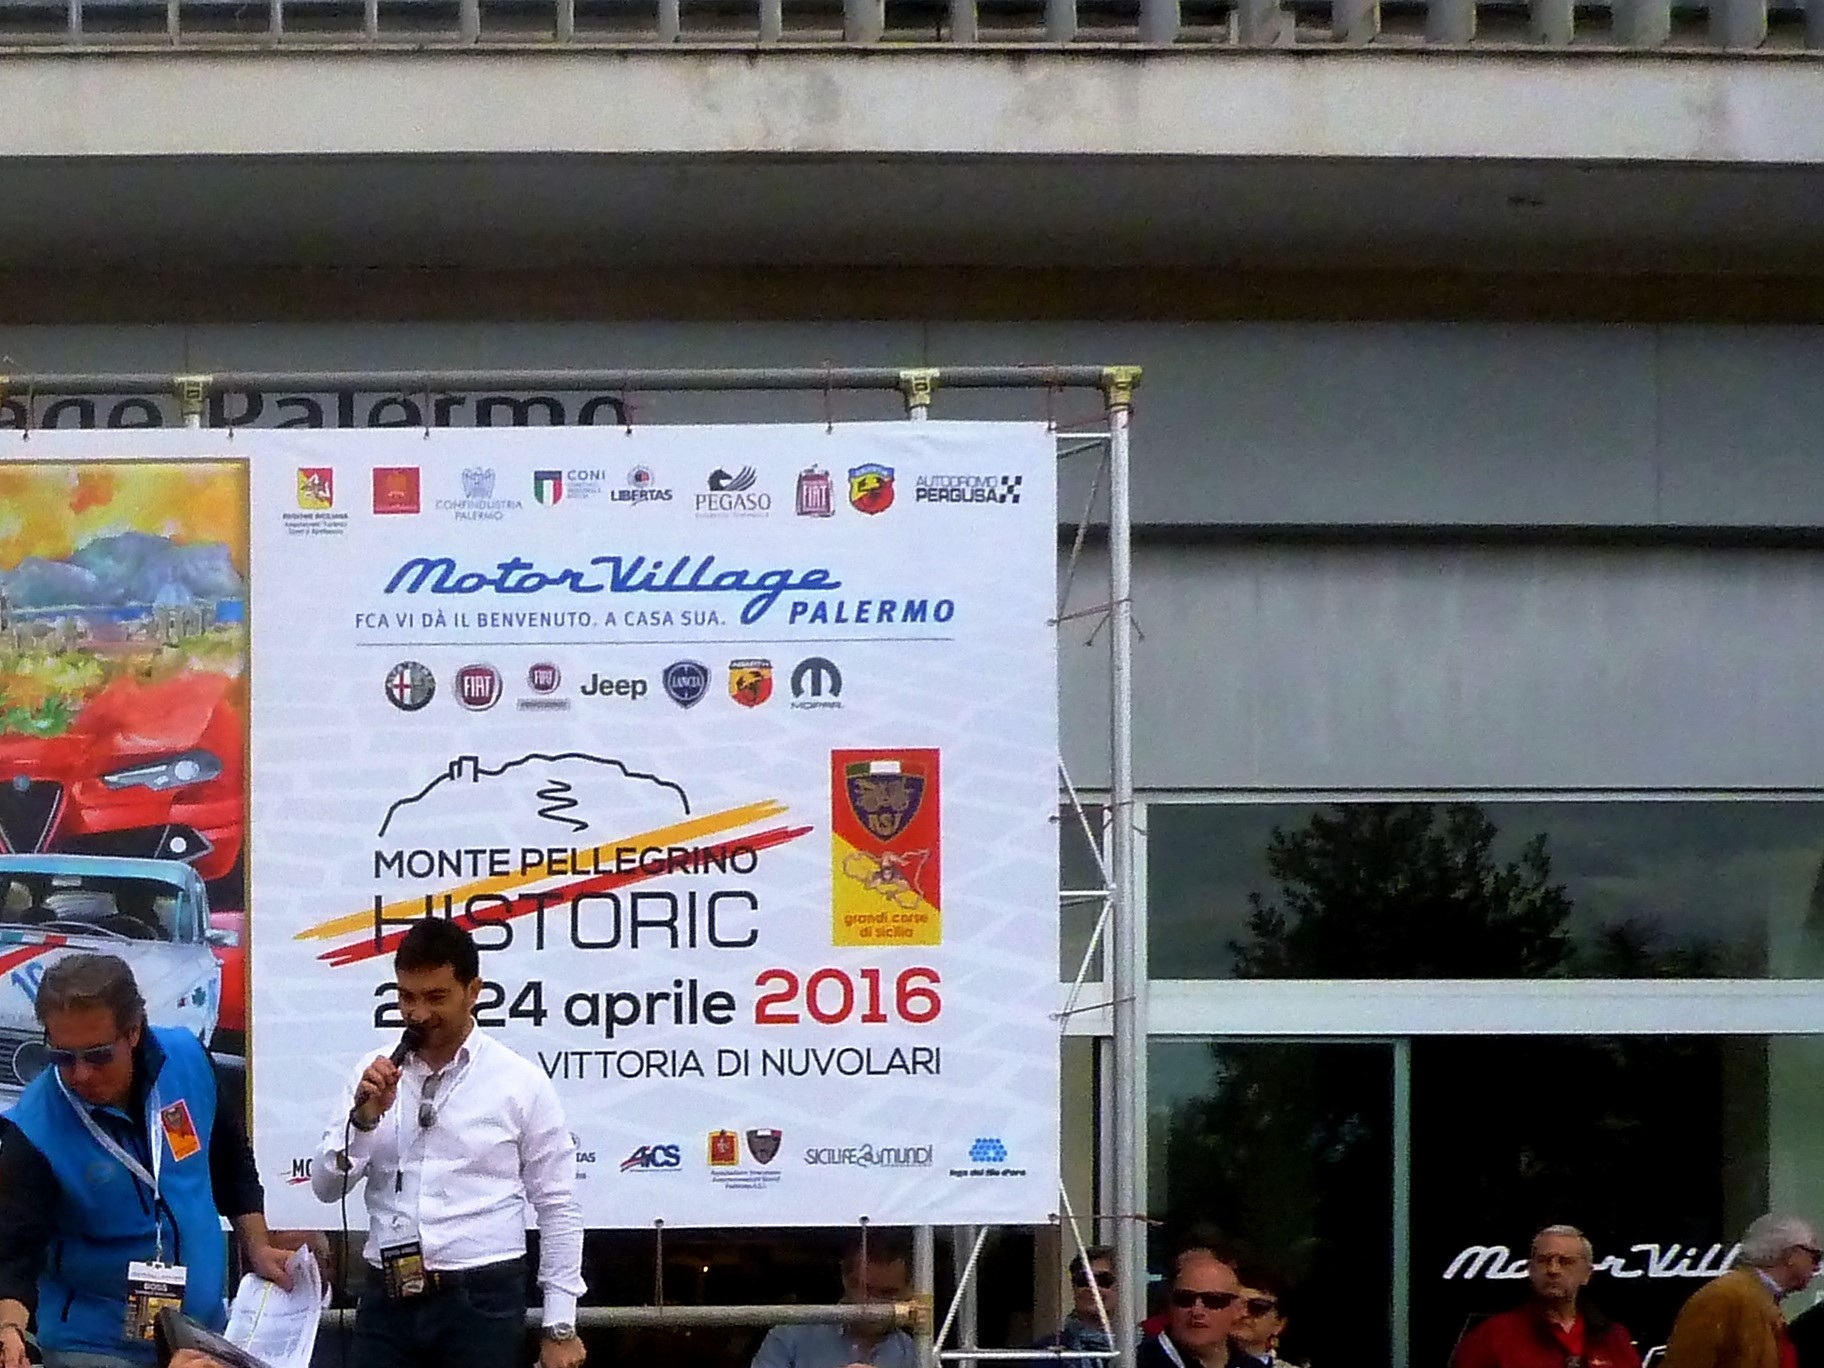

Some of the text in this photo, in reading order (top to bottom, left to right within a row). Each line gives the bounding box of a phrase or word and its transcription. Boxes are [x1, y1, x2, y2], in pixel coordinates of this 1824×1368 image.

[567, 469, 606, 481] CONI
[916, 476, 998, 488] AUTODROMO
[610, 489, 673, 502] LIBERTAS
[695, 493, 772, 511] PEGASO
[916, 488, 1000, 504] PERGUSA
[455, 511, 504, 521] PALERMO
[355, 612, 390, 629] FCA
[395, 612, 414, 629] VI
[454, 612, 471, 628] IL
[604, 610, 618, 627] A
[624, 609, 674, 627] CASA
[680, 610, 726, 627] SUA.
[788, 598, 956, 625] PALERMO
[463, 675, 492, 698] FIAT
[580, 673, 648, 700] Jeep
[374, 846, 758, 879] MONTE PELLEGRINO
[844, 912, 888, 926] grandi
[563, 978, 736, 1039] aprile
[753, 966, 942, 1026] 2016
[537, 1047, 942, 1079] VITTORIA DI NUVOLARI
